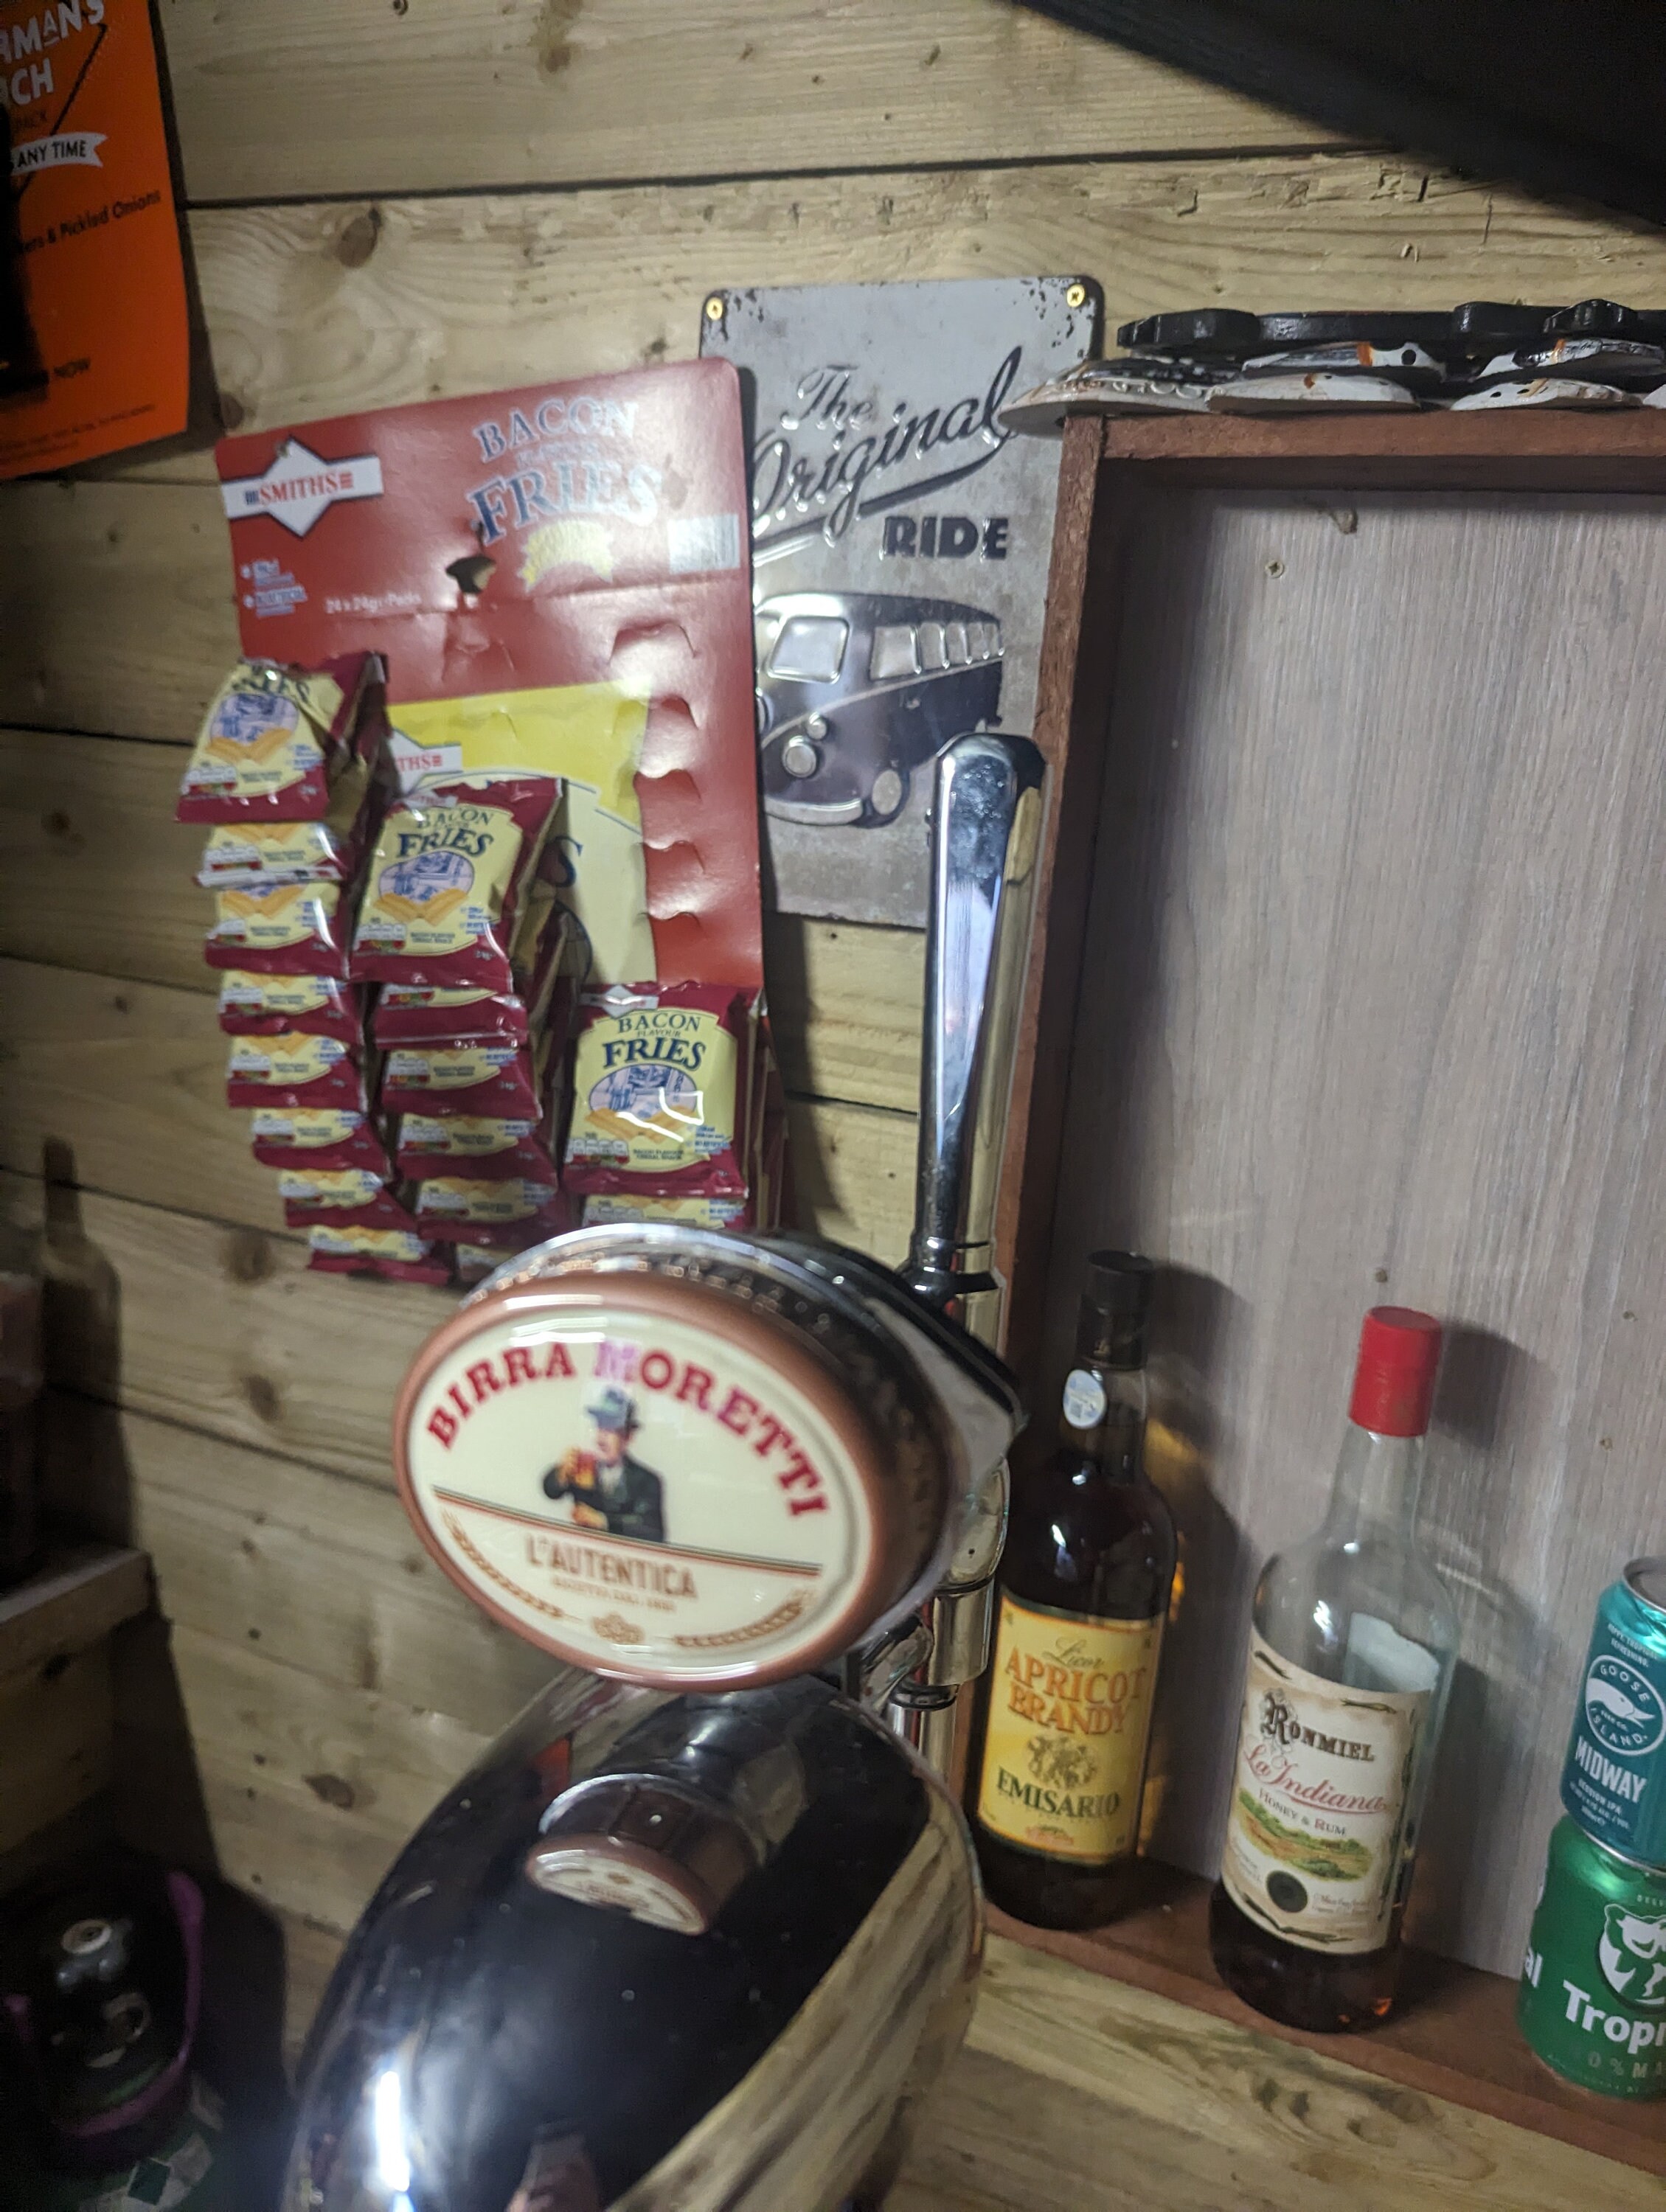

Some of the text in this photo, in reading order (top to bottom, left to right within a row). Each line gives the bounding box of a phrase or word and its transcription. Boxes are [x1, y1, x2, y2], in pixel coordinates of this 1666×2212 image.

[10, 57, 55, 105] CH
[17, 139, 87, 168] ANY TIME
[60, 206, 109, 237] Pickled
[113, 190, 162, 218] Onions
[780, 364, 875, 430] The
[473, 396, 639, 463] BACON
[752, 346, 1024, 547] Original
[259, 472, 339, 507] SMITHS
[467, 461, 663, 545] FRIES
[883, 516, 1009, 560] RIDE
[397, 827, 493, 858] FRIES
[417, 807, 493, 829] BACON
[618, 1013, 701, 1033] BACON
[602, 1036, 707, 1071] FRIES
[427, 1340, 830, 1518] BIRRA MORETTI
[524, 1534, 698, 1600] L'AUTENTICA
[1004, 1645, 1148, 1705] APRICOT
[1599, 1663, 1651, 1703] GOOSE
[1007, 1680, 1127, 1735] BRANDY
[1589, 1706, 1643, 1746] ISLAND
[996, 1765, 1121, 1819] EMISARIO
[1243, 1736, 1386, 1813] La Indiana
[1575, 1735, 1648, 1804] MIDWAY
[1258, 1787, 1347, 1837] HONEY & RUM
